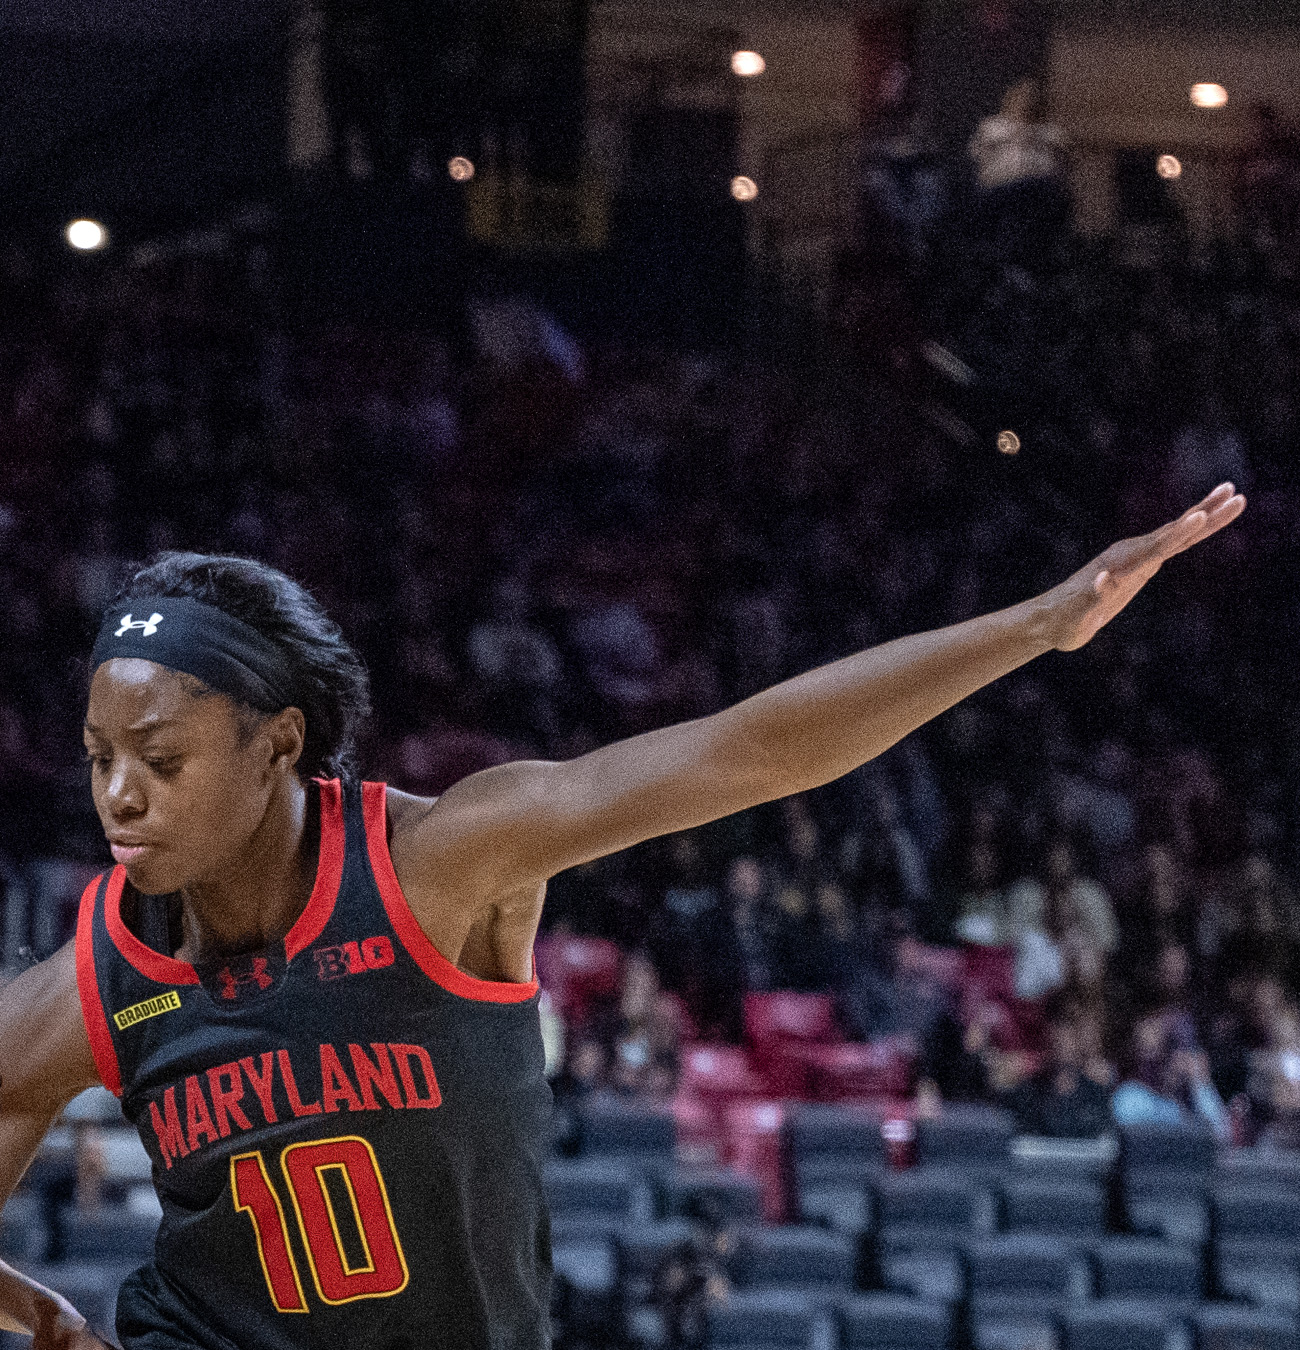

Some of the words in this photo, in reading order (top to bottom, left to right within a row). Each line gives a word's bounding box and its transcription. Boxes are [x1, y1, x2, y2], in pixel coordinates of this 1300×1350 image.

[117, 993, 179, 1028] GRADUATE
[149, 1043, 442, 1170] MARYLAND
[230, 1135, 410, 1313] 10
